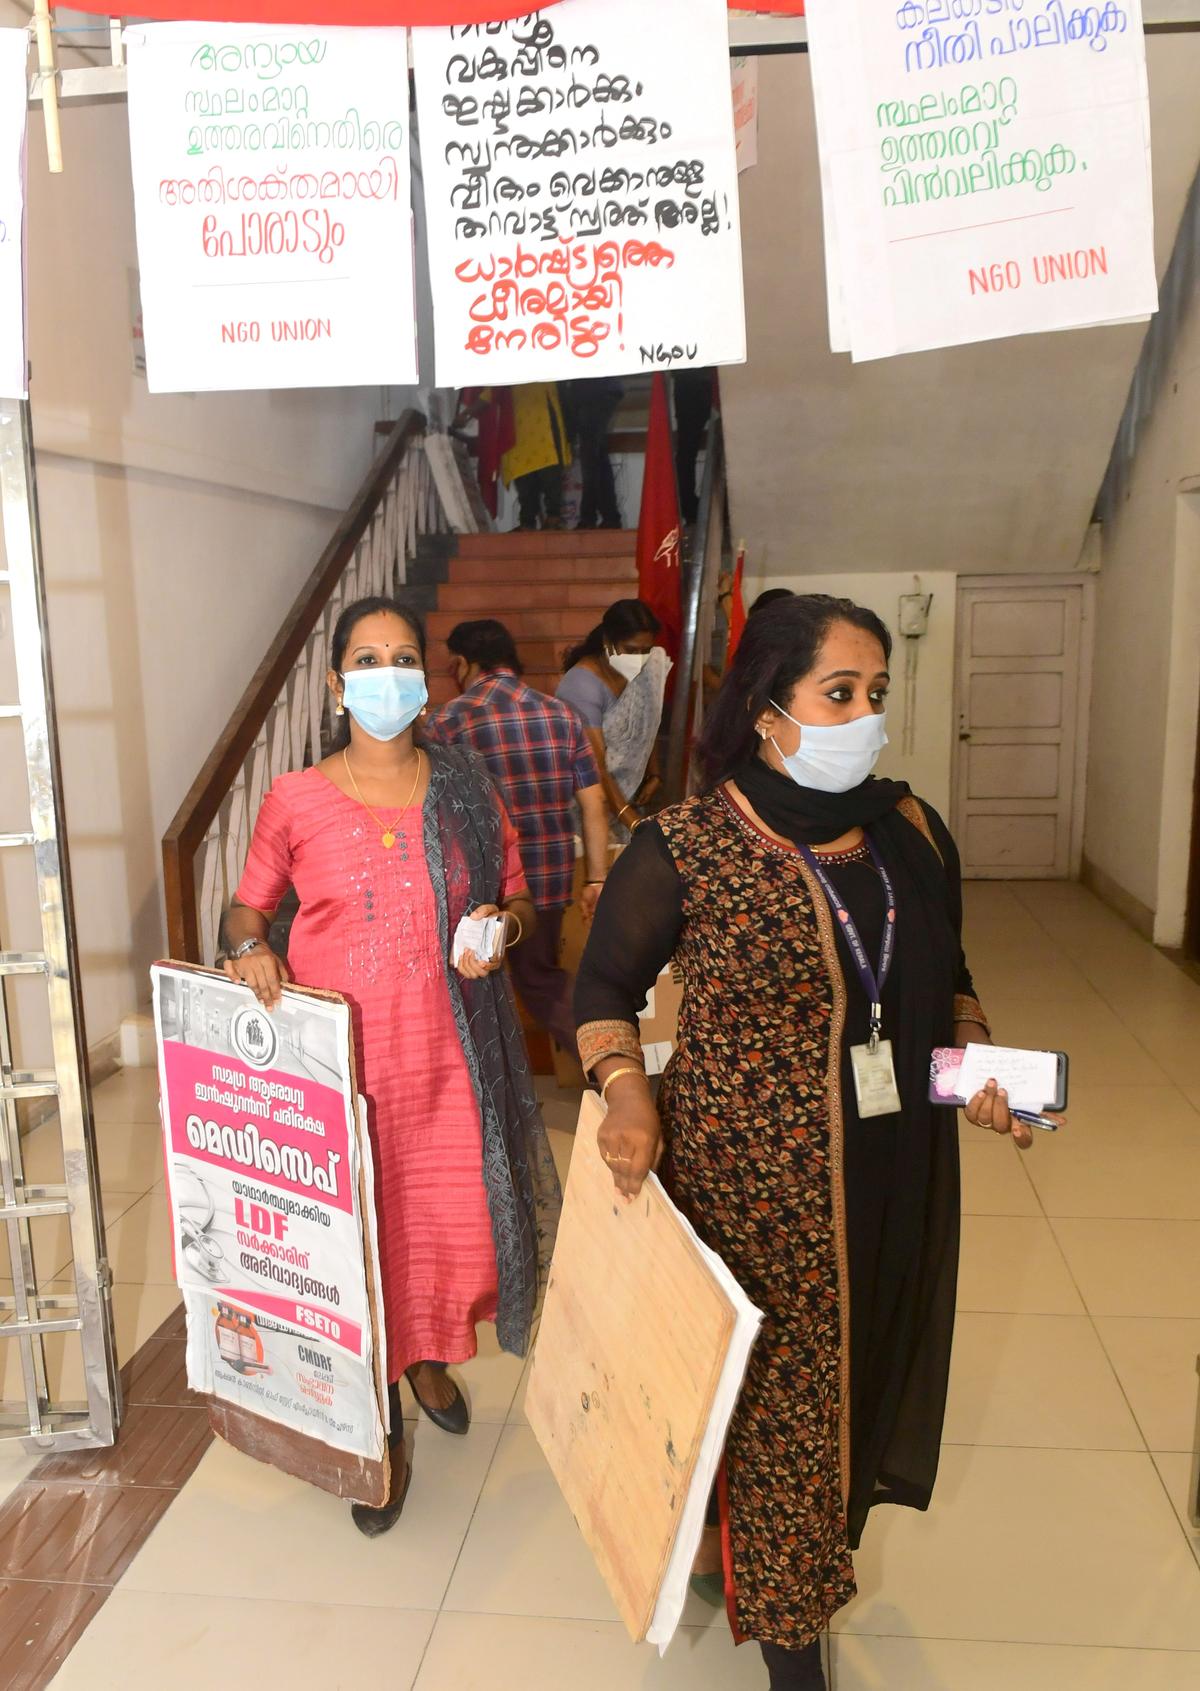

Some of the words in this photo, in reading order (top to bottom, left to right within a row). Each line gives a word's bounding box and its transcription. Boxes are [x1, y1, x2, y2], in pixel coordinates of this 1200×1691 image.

[191, 39, 328, 80] അന്യായ
[905, 20, 982, 72] നീതി
[187, 108, 403, 155] ഉത്തരവിനെതിരെ
[202, 209, 345, 264] പോരാടും
[968, 260, 1021, 295] NGO
[1033, 246, 1108, 285] UNION
[222, 320, 262, 343] NGO
[271, 318, 332, 341] UNION
[212, 1064, 246, 1091] സമഗ്ര
[249, 1076, 304, 1111] ആരോഗ്യ
[273, 1107, 325, 1137] പരിരക്ഷ
[186, 1114, 341, 1198] മെഡിസെപ്
[234, 1197, 288, 1241] LDF
[236, 1230, 310, 1270] സർക്കാരിന്
[240, 1251, 340, 1305] അഭിവാദ്യങ്ങൾ
[295, 1304, 341, 1340] FSETO
[298, 1345, 332, 1372] CMDRF
